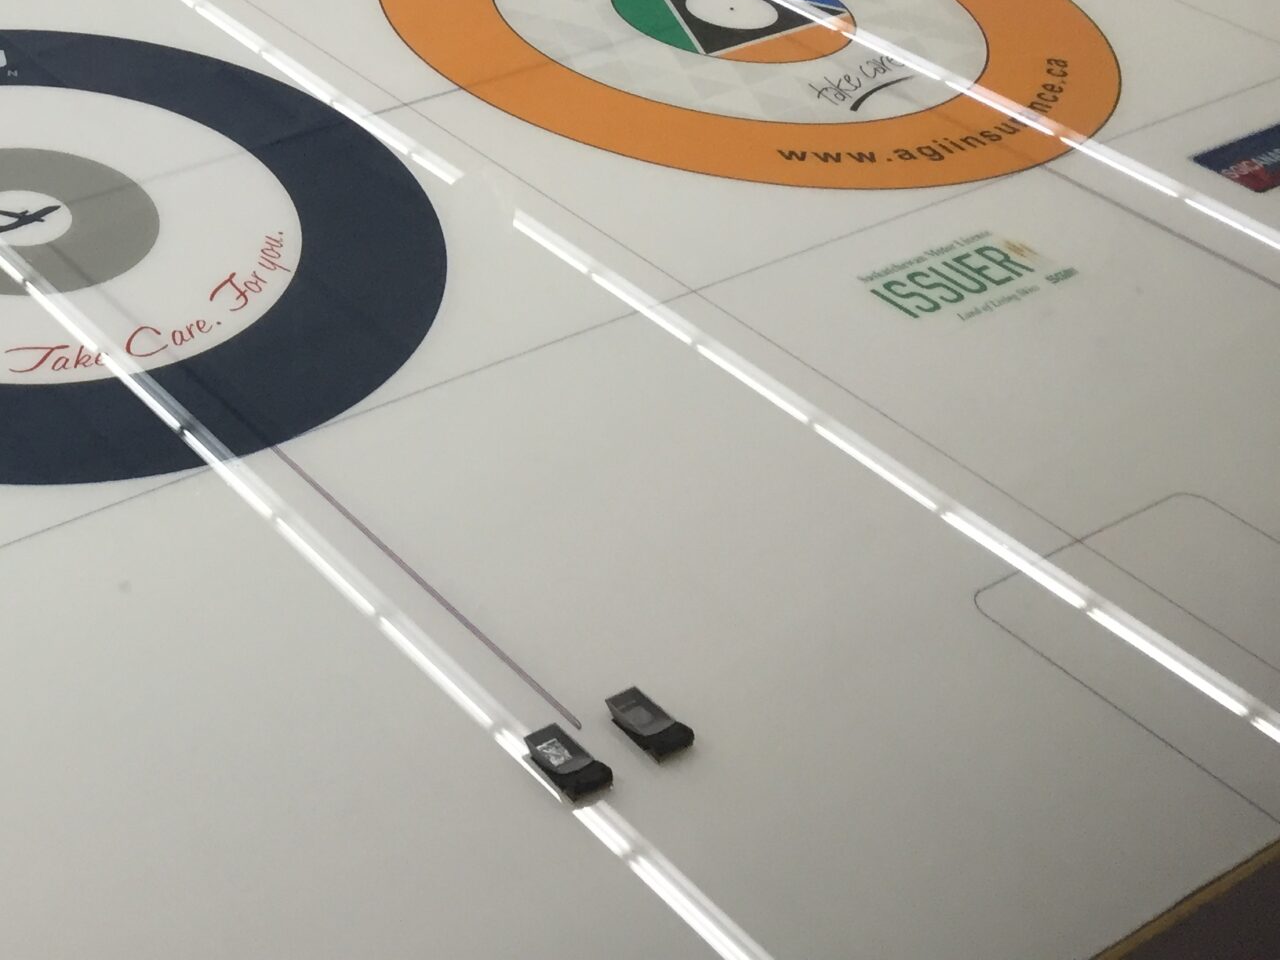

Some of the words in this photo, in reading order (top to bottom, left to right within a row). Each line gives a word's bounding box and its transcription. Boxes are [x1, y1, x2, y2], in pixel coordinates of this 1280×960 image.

[777, 58, 1068, 164] www.agiinsunce.ca
[4, 344, 110, 374] Take
[125, 318, 222, 358] Care.
[209, 271, 270, 312] For
[257, 230, 292, 273] you.
[870, 245, 1035, 318] ISSUER
